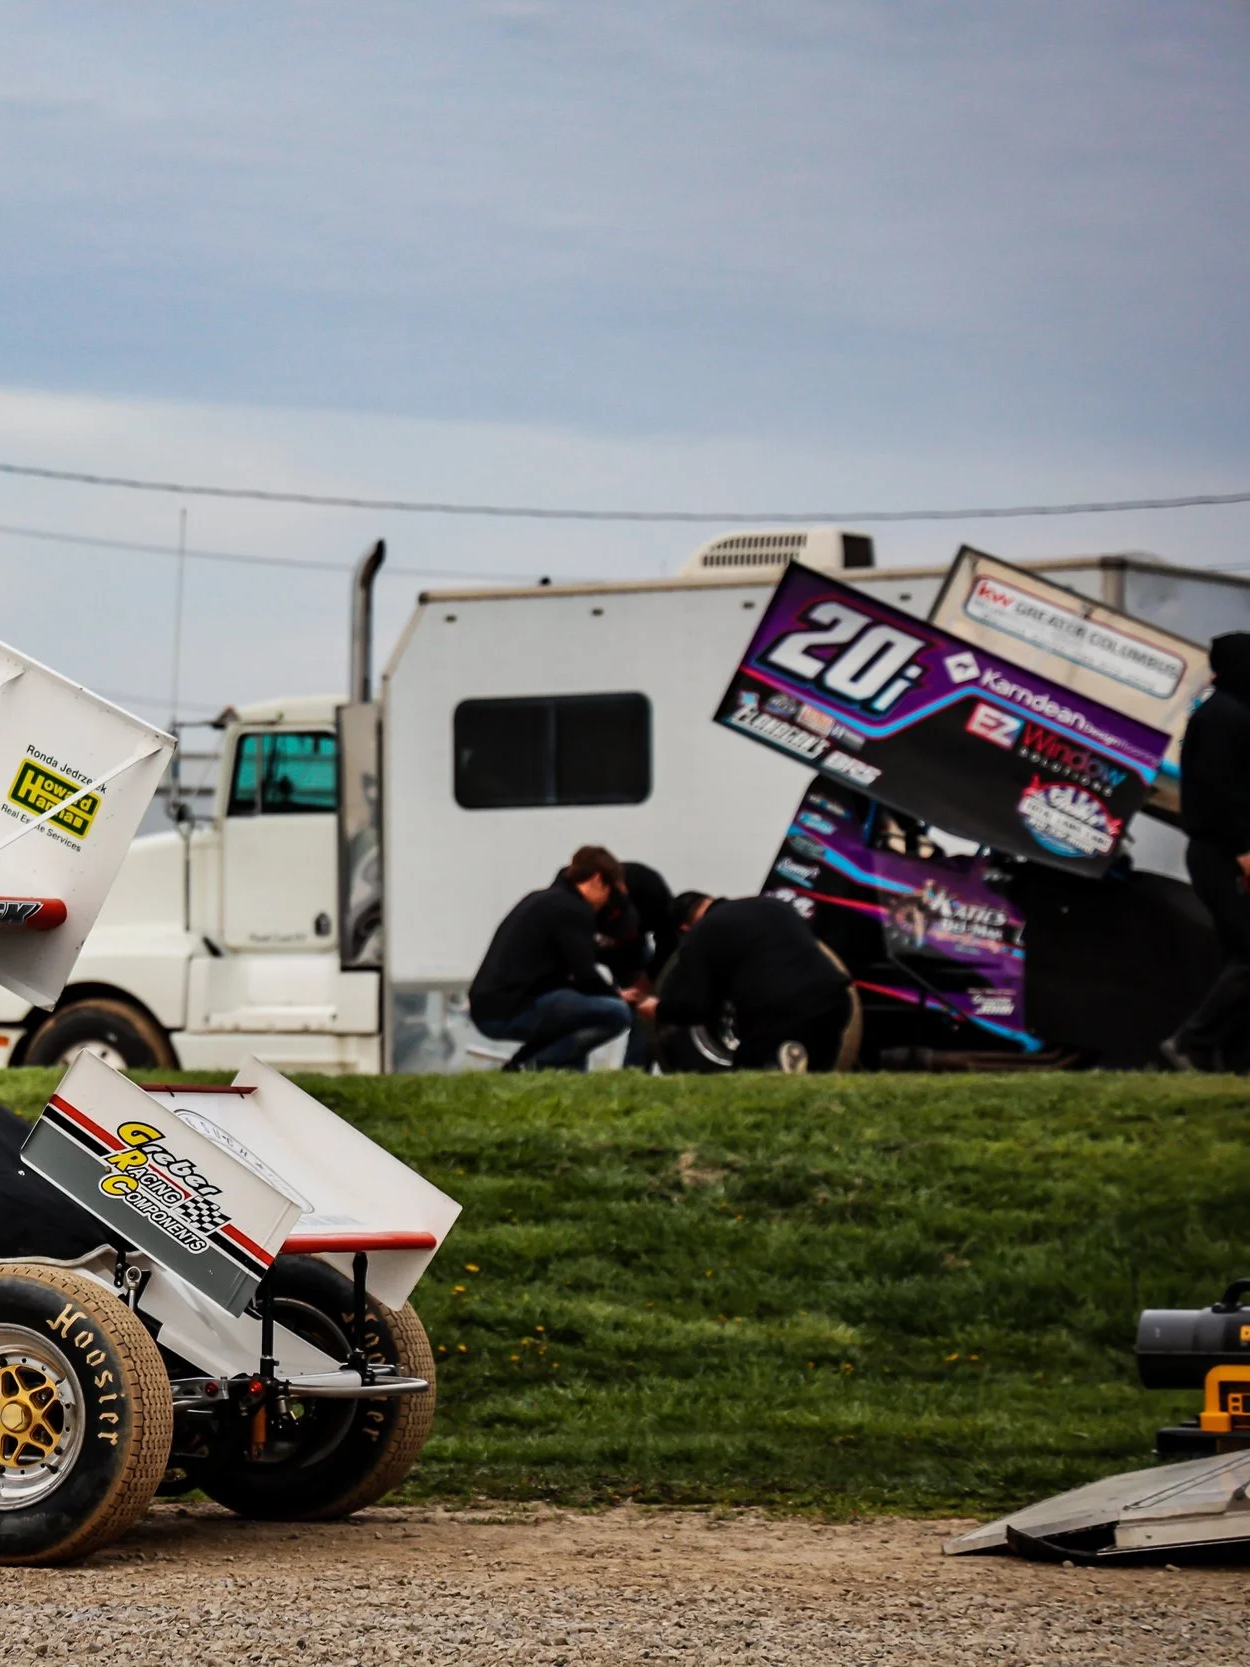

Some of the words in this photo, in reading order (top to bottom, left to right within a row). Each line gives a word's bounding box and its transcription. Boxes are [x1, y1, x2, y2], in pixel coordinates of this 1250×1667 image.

[26, 744, 58, 768] Ronda
[60, 764, 107, 794] Jedrzek
[973, 704, 1022, 747] EZ
[1024, 722, 1128, 787] Window
[18, 770, 93, 811] Howad
[1, 803, 20, 818] Real
[20, 815, 45, 832] Este
[46, 829, 81, 852] Services
[105, 1148, 184, 1206] RACING
[117, 1121, 223, 1197] Greber
[100, 1174, 208, 1252] COMPONENTS
